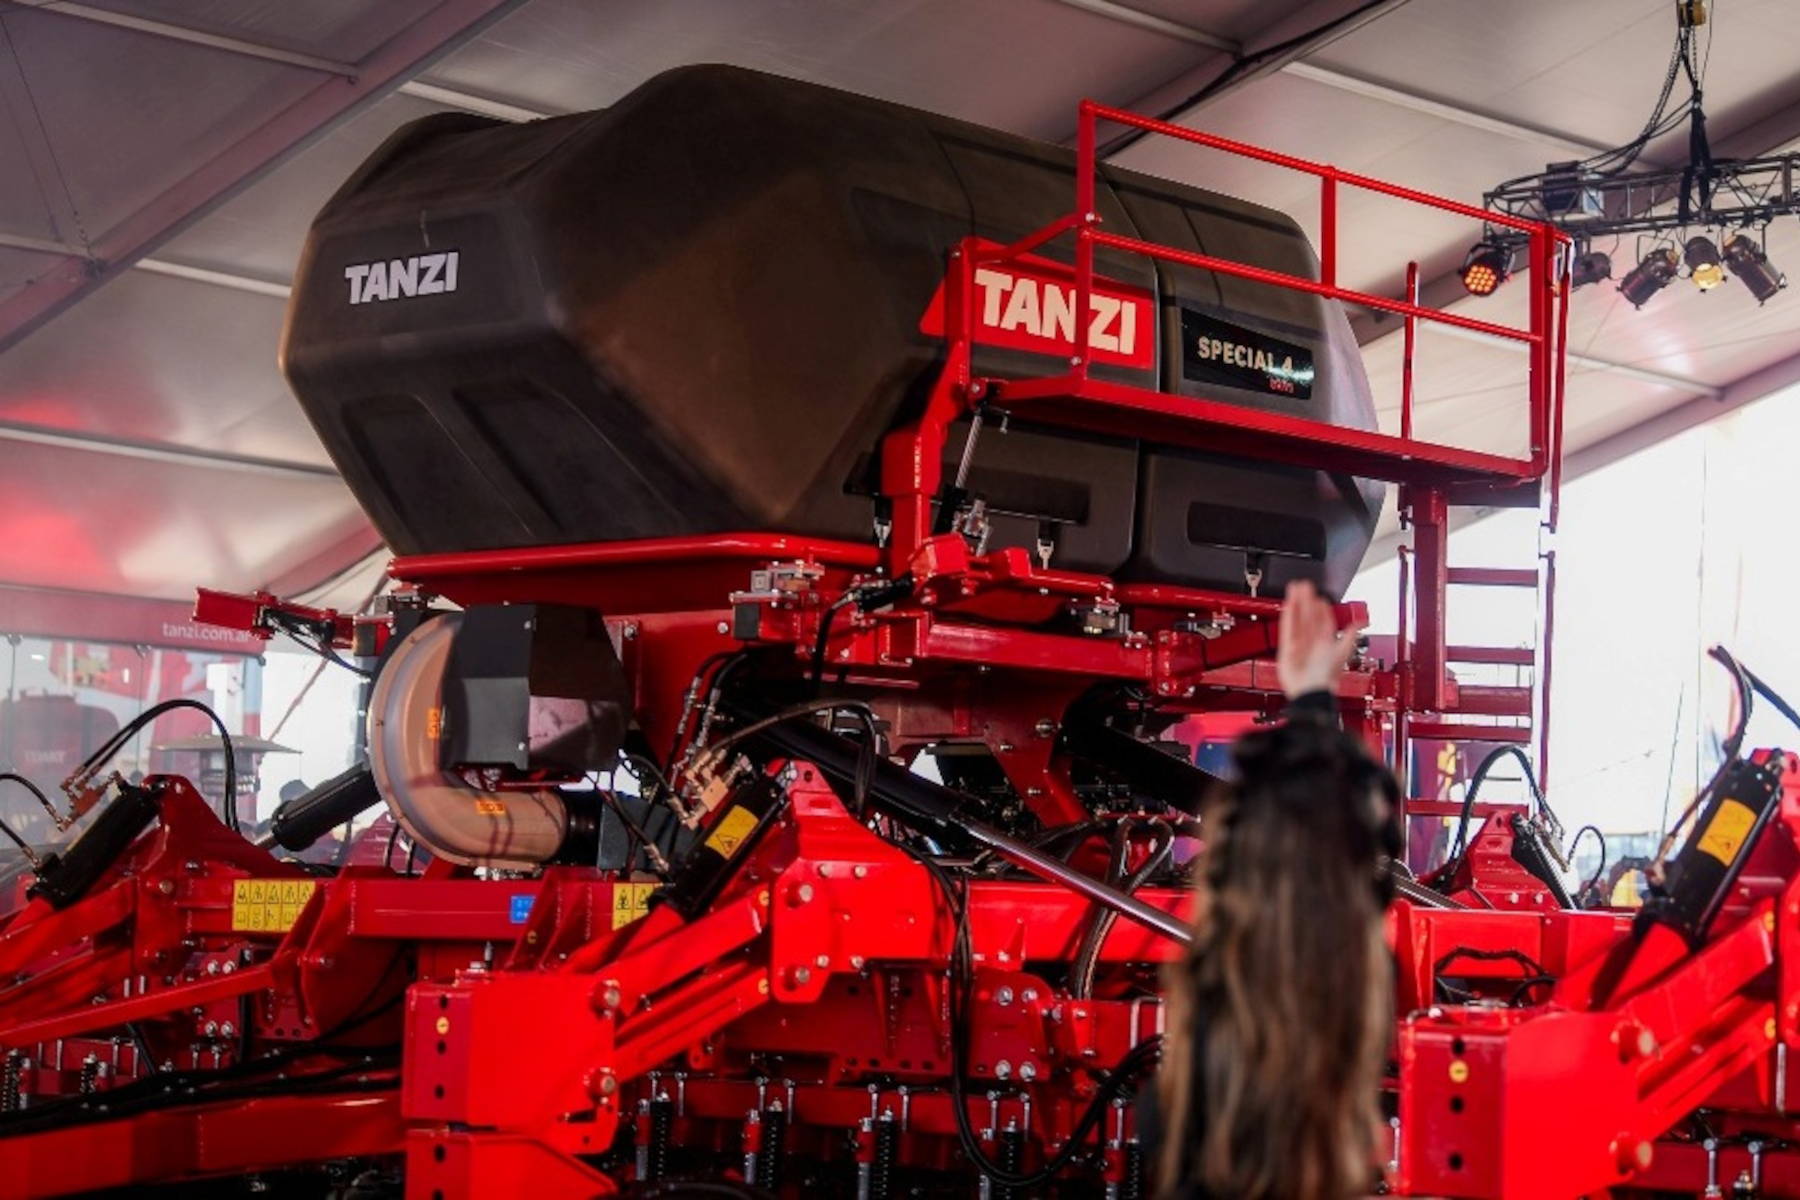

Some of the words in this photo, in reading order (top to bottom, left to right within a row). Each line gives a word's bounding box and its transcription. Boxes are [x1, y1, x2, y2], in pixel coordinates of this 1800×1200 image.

[345, 252, 459, 304] TANZI
[974, 268, 1137, 355] TANZI
[1197, 335, 1275, 374] SPECIAL
[1281, 355, 1294, 376] 4
